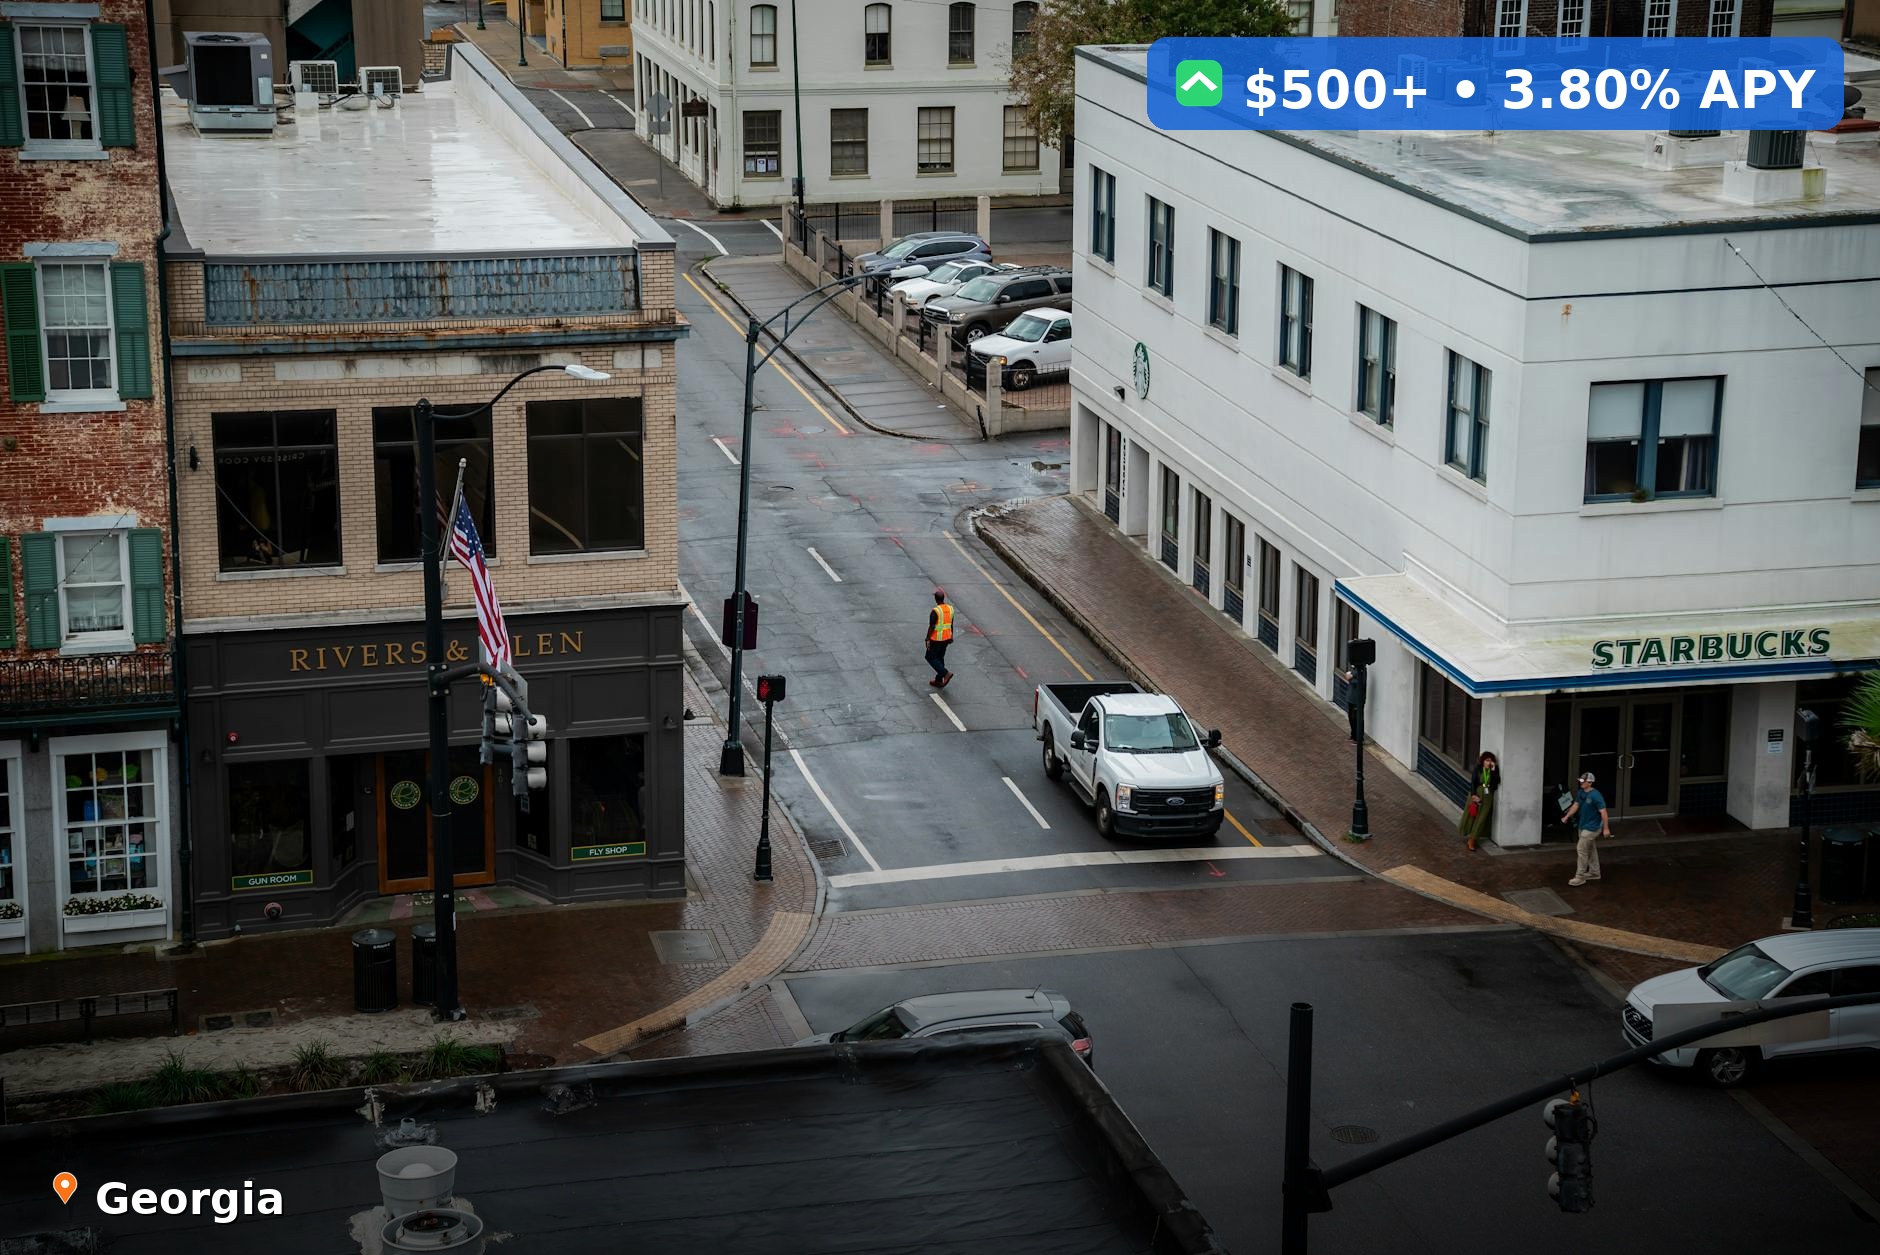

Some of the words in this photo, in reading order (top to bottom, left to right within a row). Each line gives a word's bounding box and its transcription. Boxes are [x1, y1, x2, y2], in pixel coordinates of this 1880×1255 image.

[289, 640, 427, 673] RIVERS
[445, 639, 469, 662] &
[513, 630, 584, 658] LEN
[1591, 627, 1831, 669] STARBUCKS
[589, 848, 604, 856] FLY
[605, 846, 628, 855] SHOP
[248, 877, 268, 886] GUN
[270, 874, 297, 884] ROOM
